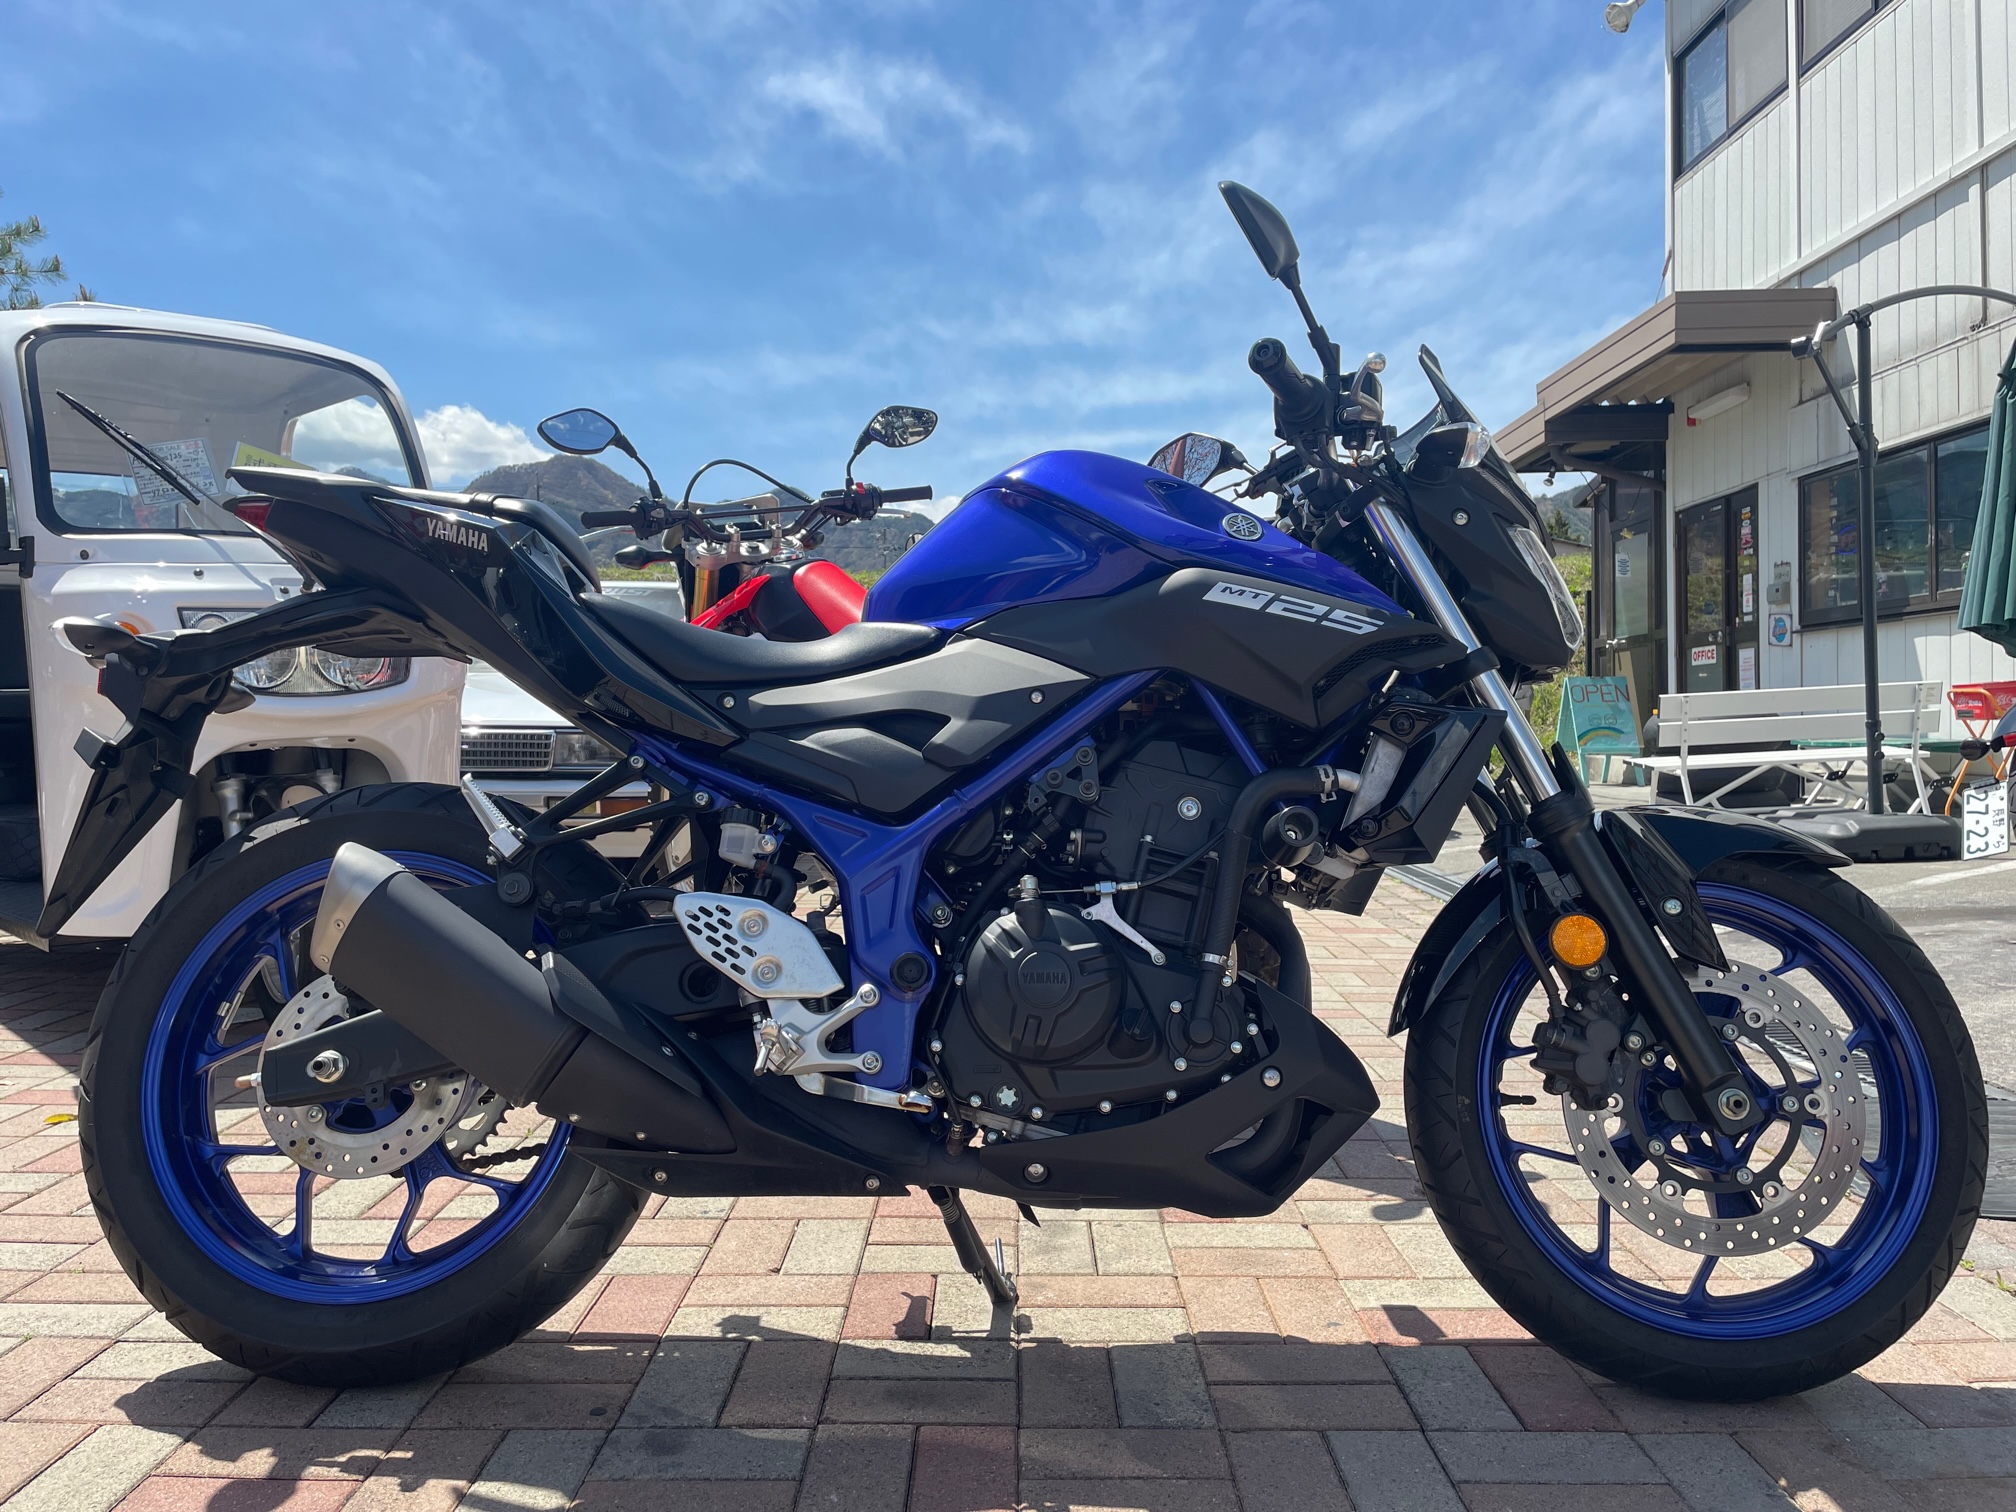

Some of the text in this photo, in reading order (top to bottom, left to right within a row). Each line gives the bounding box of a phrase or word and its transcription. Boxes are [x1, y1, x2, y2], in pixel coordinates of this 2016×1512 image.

[427, 518, 488, 552] YAMAHA
[1265, 595, 1385, 635] 25
[1693, 649, 1715, 661] OFFICE
[1570, 684, 1631, 703] OPEN
[1966, 789, 1989, 855] 27-23
[1992, 808, 2005, 827] 長野
[1022, 972, 1067, 984] YAMAHA
